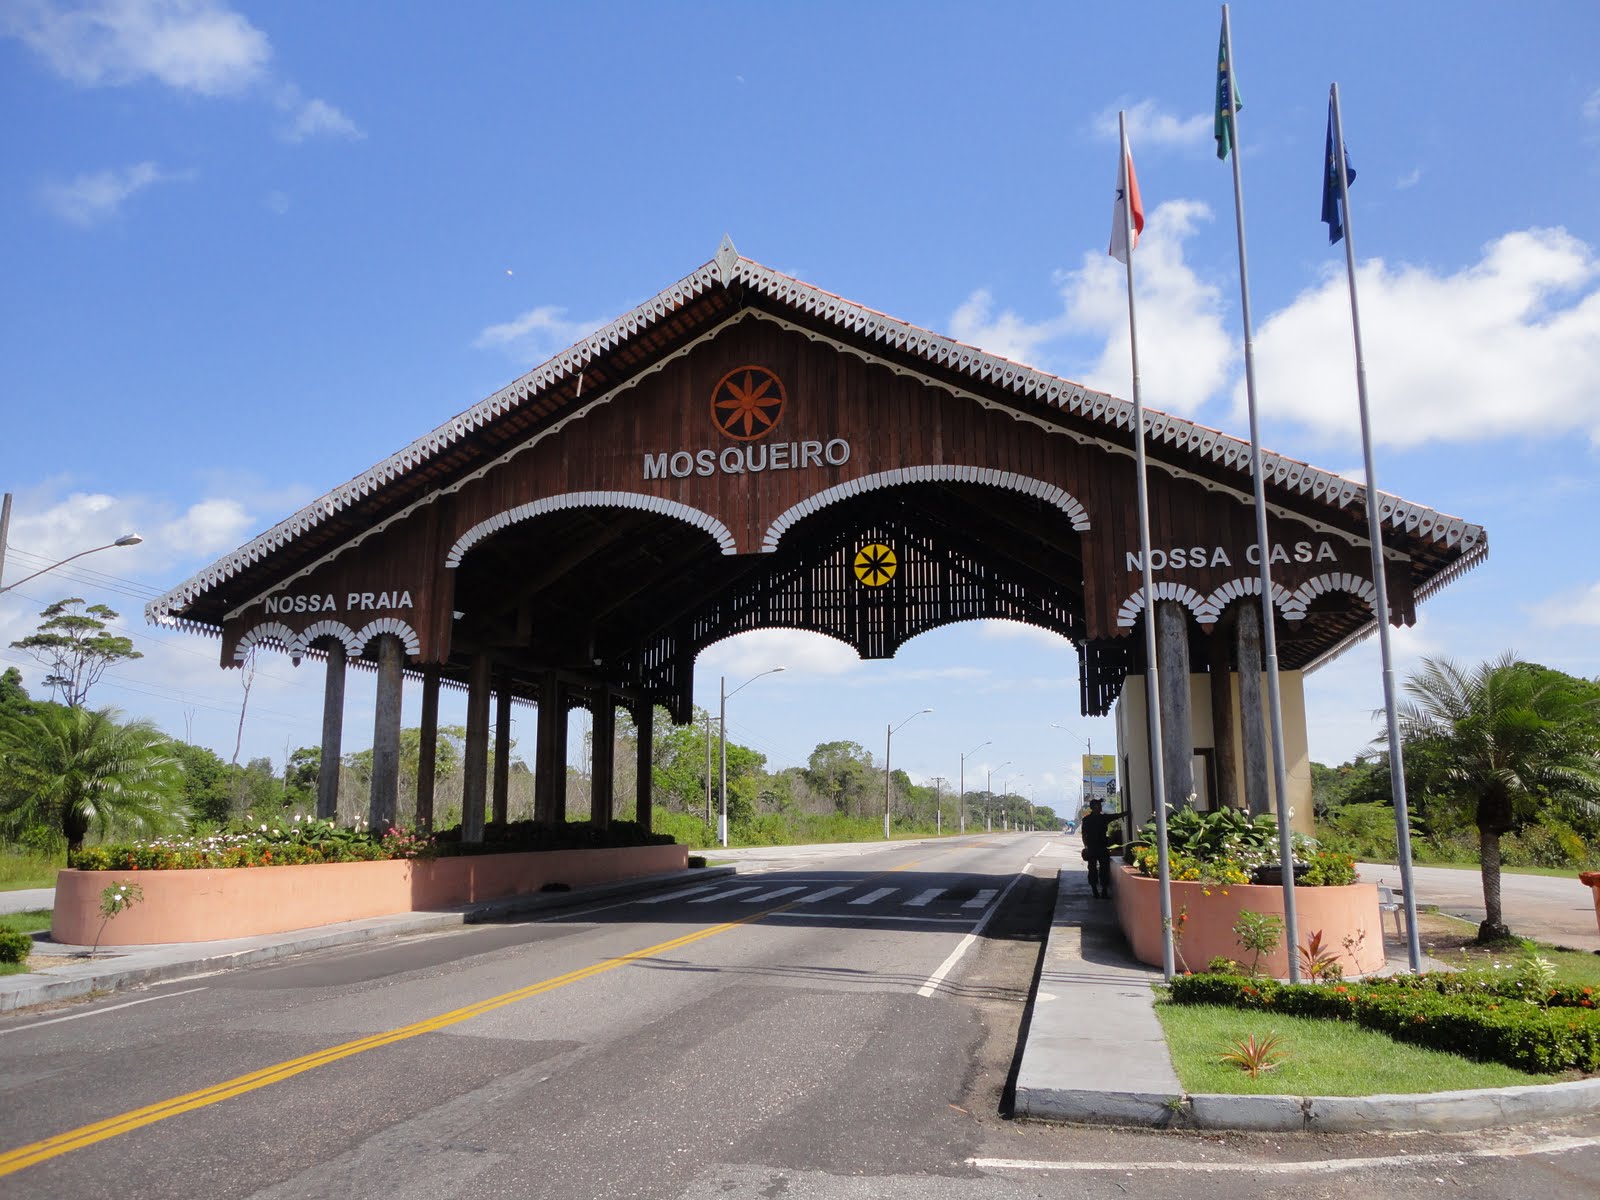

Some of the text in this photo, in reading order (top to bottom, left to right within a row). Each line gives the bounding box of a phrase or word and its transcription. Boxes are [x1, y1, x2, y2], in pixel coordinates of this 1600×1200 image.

[643, 438, 851, 480] MOSQUEIRO
[1126, 541, 1338, 571] NOSSA CASA
[265, 591, 413, 614] NOSSA PRAIA
